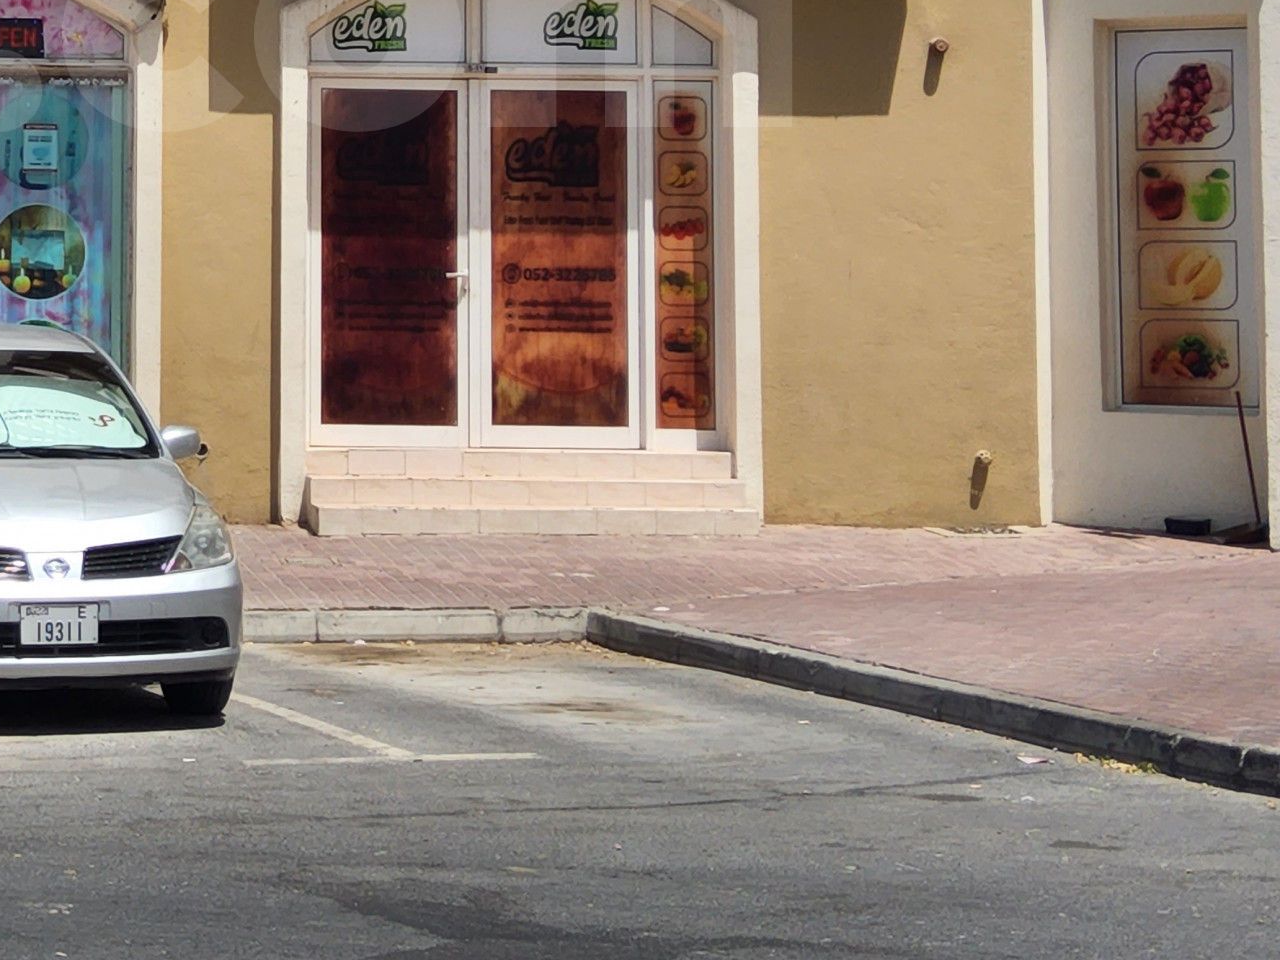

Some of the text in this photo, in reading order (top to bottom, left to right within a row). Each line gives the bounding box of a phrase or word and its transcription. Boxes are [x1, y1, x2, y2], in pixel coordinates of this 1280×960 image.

[334, 6, 406, 40] eden
[545, 3, 617, 38] eden
[78, 606, 87, 619] E
[37, 622, 81, 642] 19311
